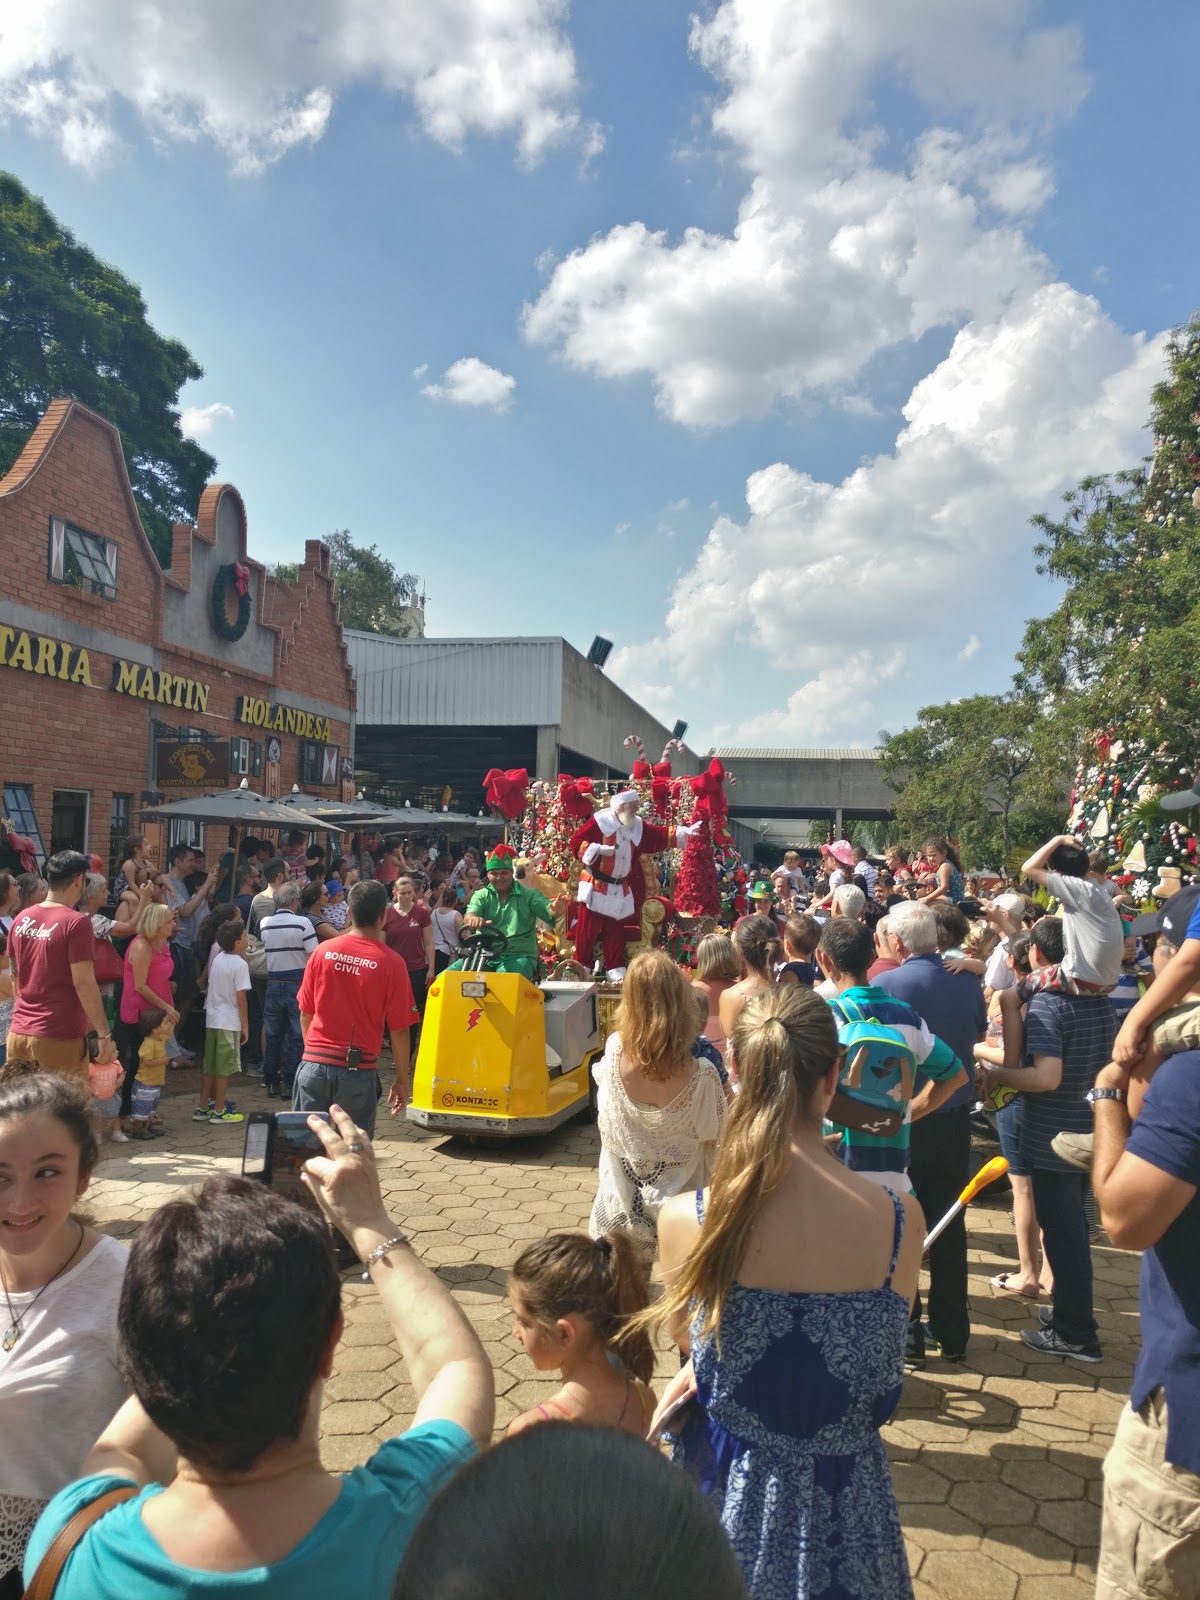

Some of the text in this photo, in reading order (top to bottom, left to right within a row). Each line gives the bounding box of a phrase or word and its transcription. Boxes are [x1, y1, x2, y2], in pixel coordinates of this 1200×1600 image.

[115, 660, 210, 712] MARTIN
[240, 695, 331, 743] HOLANDESA
[168, 743, 216, 765] CONFEITARIA
[186, 778, 225, 786] HOLANDESA
[324, 951, 378, 970] BOMBEIRO
[334, 962, 361, 976] CIVIL
